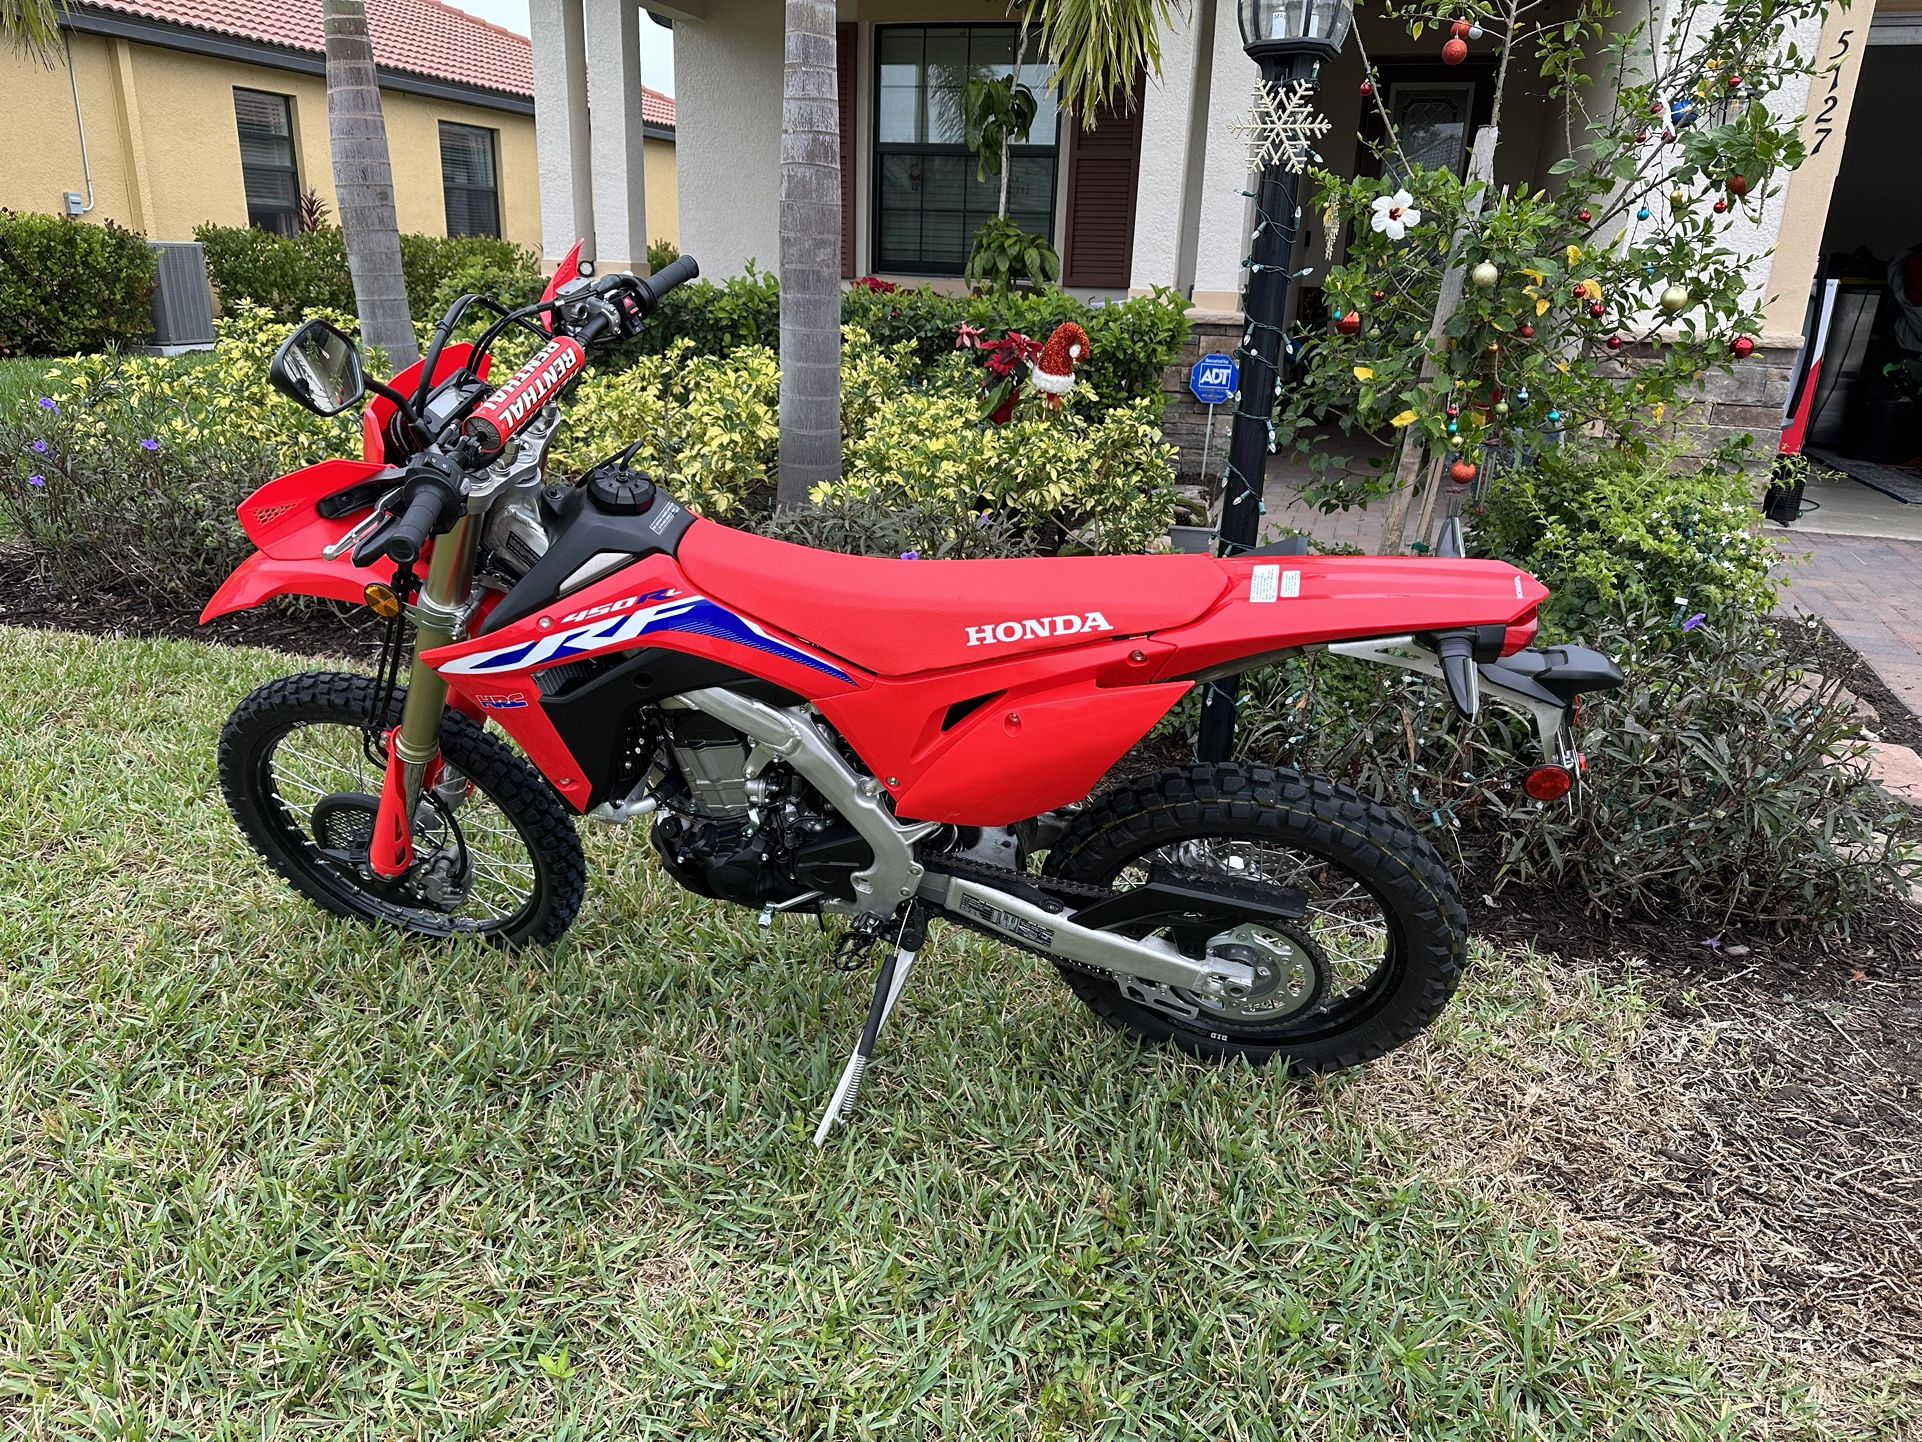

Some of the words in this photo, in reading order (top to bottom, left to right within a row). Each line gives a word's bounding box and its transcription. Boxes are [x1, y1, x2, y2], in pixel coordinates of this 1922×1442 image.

[1810, 30, 1854, 156] 5127
[484, 341, 560, 411] RENTHAL
[498, 347, 577, 429] RENTHAL
[1200, 368, 1230, 384] ADT
[438, 595, 705, 675] CRF
[965, 611, 1114, 646] HONDA
[475, 692, 528, 709] HRC
